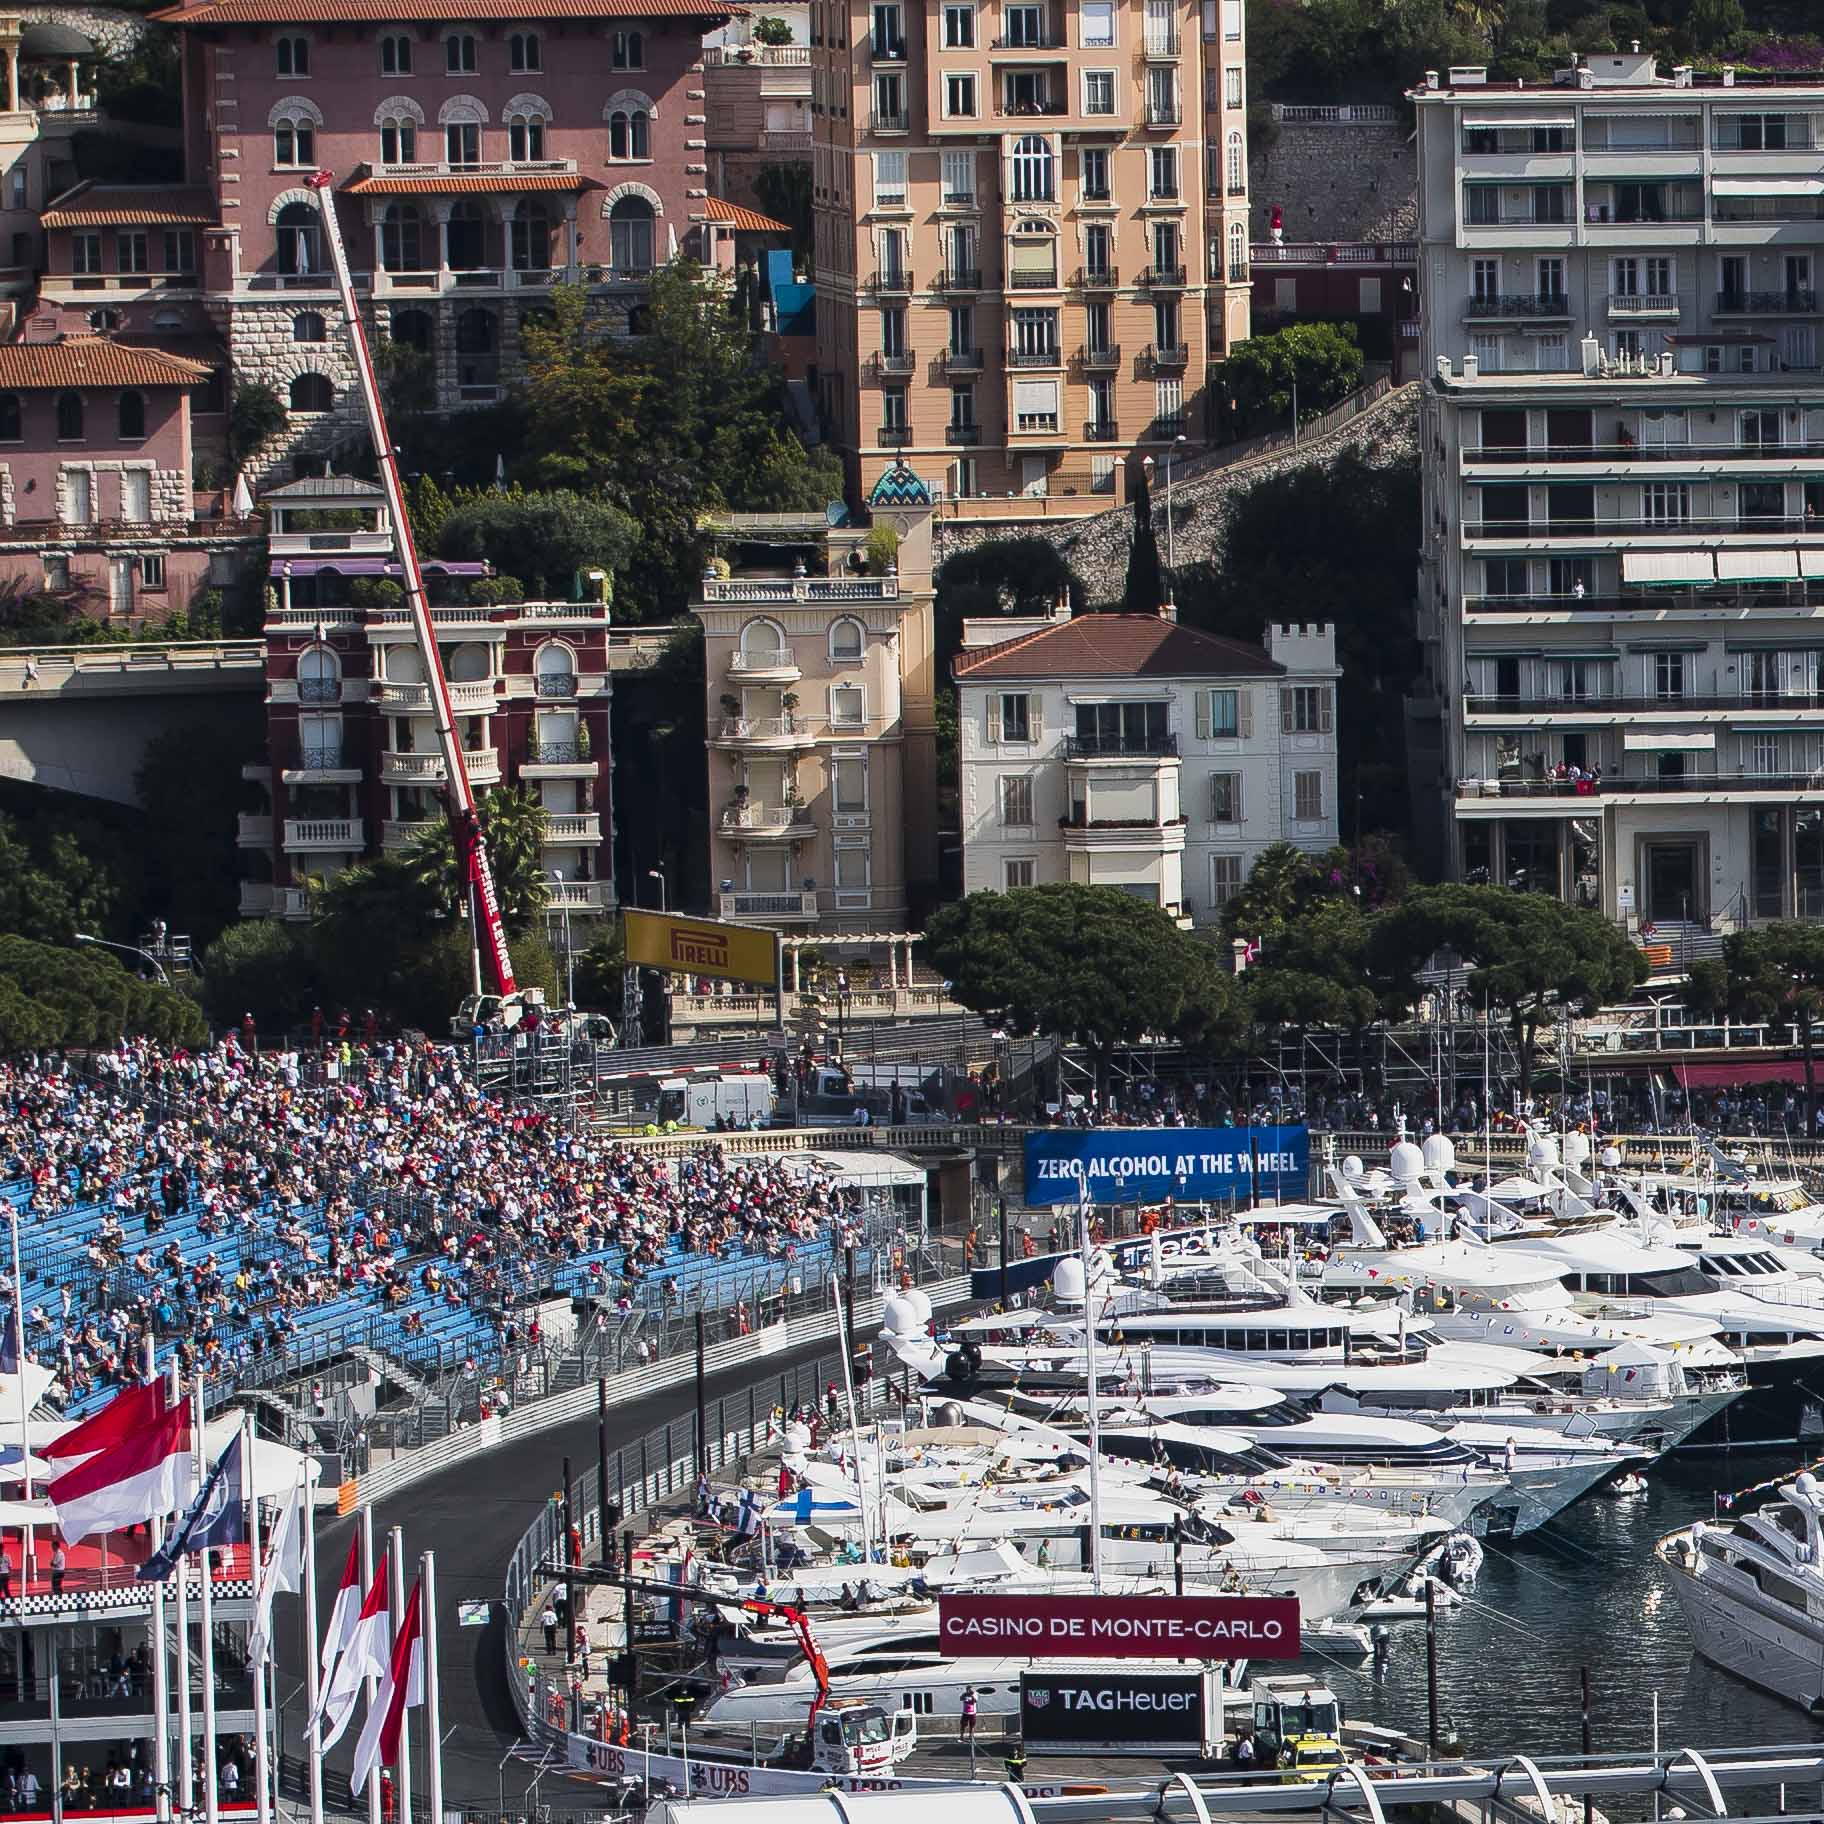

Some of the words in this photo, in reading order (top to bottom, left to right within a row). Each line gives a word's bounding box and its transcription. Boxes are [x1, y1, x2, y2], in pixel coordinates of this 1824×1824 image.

[492, 920, 514, 980] LEVAGE
[670, 927, 729, 968] PIRELLI
[1038, 1158, 1081, 1180] ZERO
[1088, 1155, 1170, 1178] ALCOHOL
[1175, 1155, 1196, 1176] AT
[1201, 1153, 1233, 1174] THE
[1237, 1152, 1298, 1174] WHEEL
[947, 1618, 1043, 1637] CASINO
[1050, 1619, 1086, 1636] DE
[1092, 1619, 1282, 1639] MONTE-CARLO
[599, 1747, 625, 1774] UBS
[709, 1767, 749, 1792] UBS
